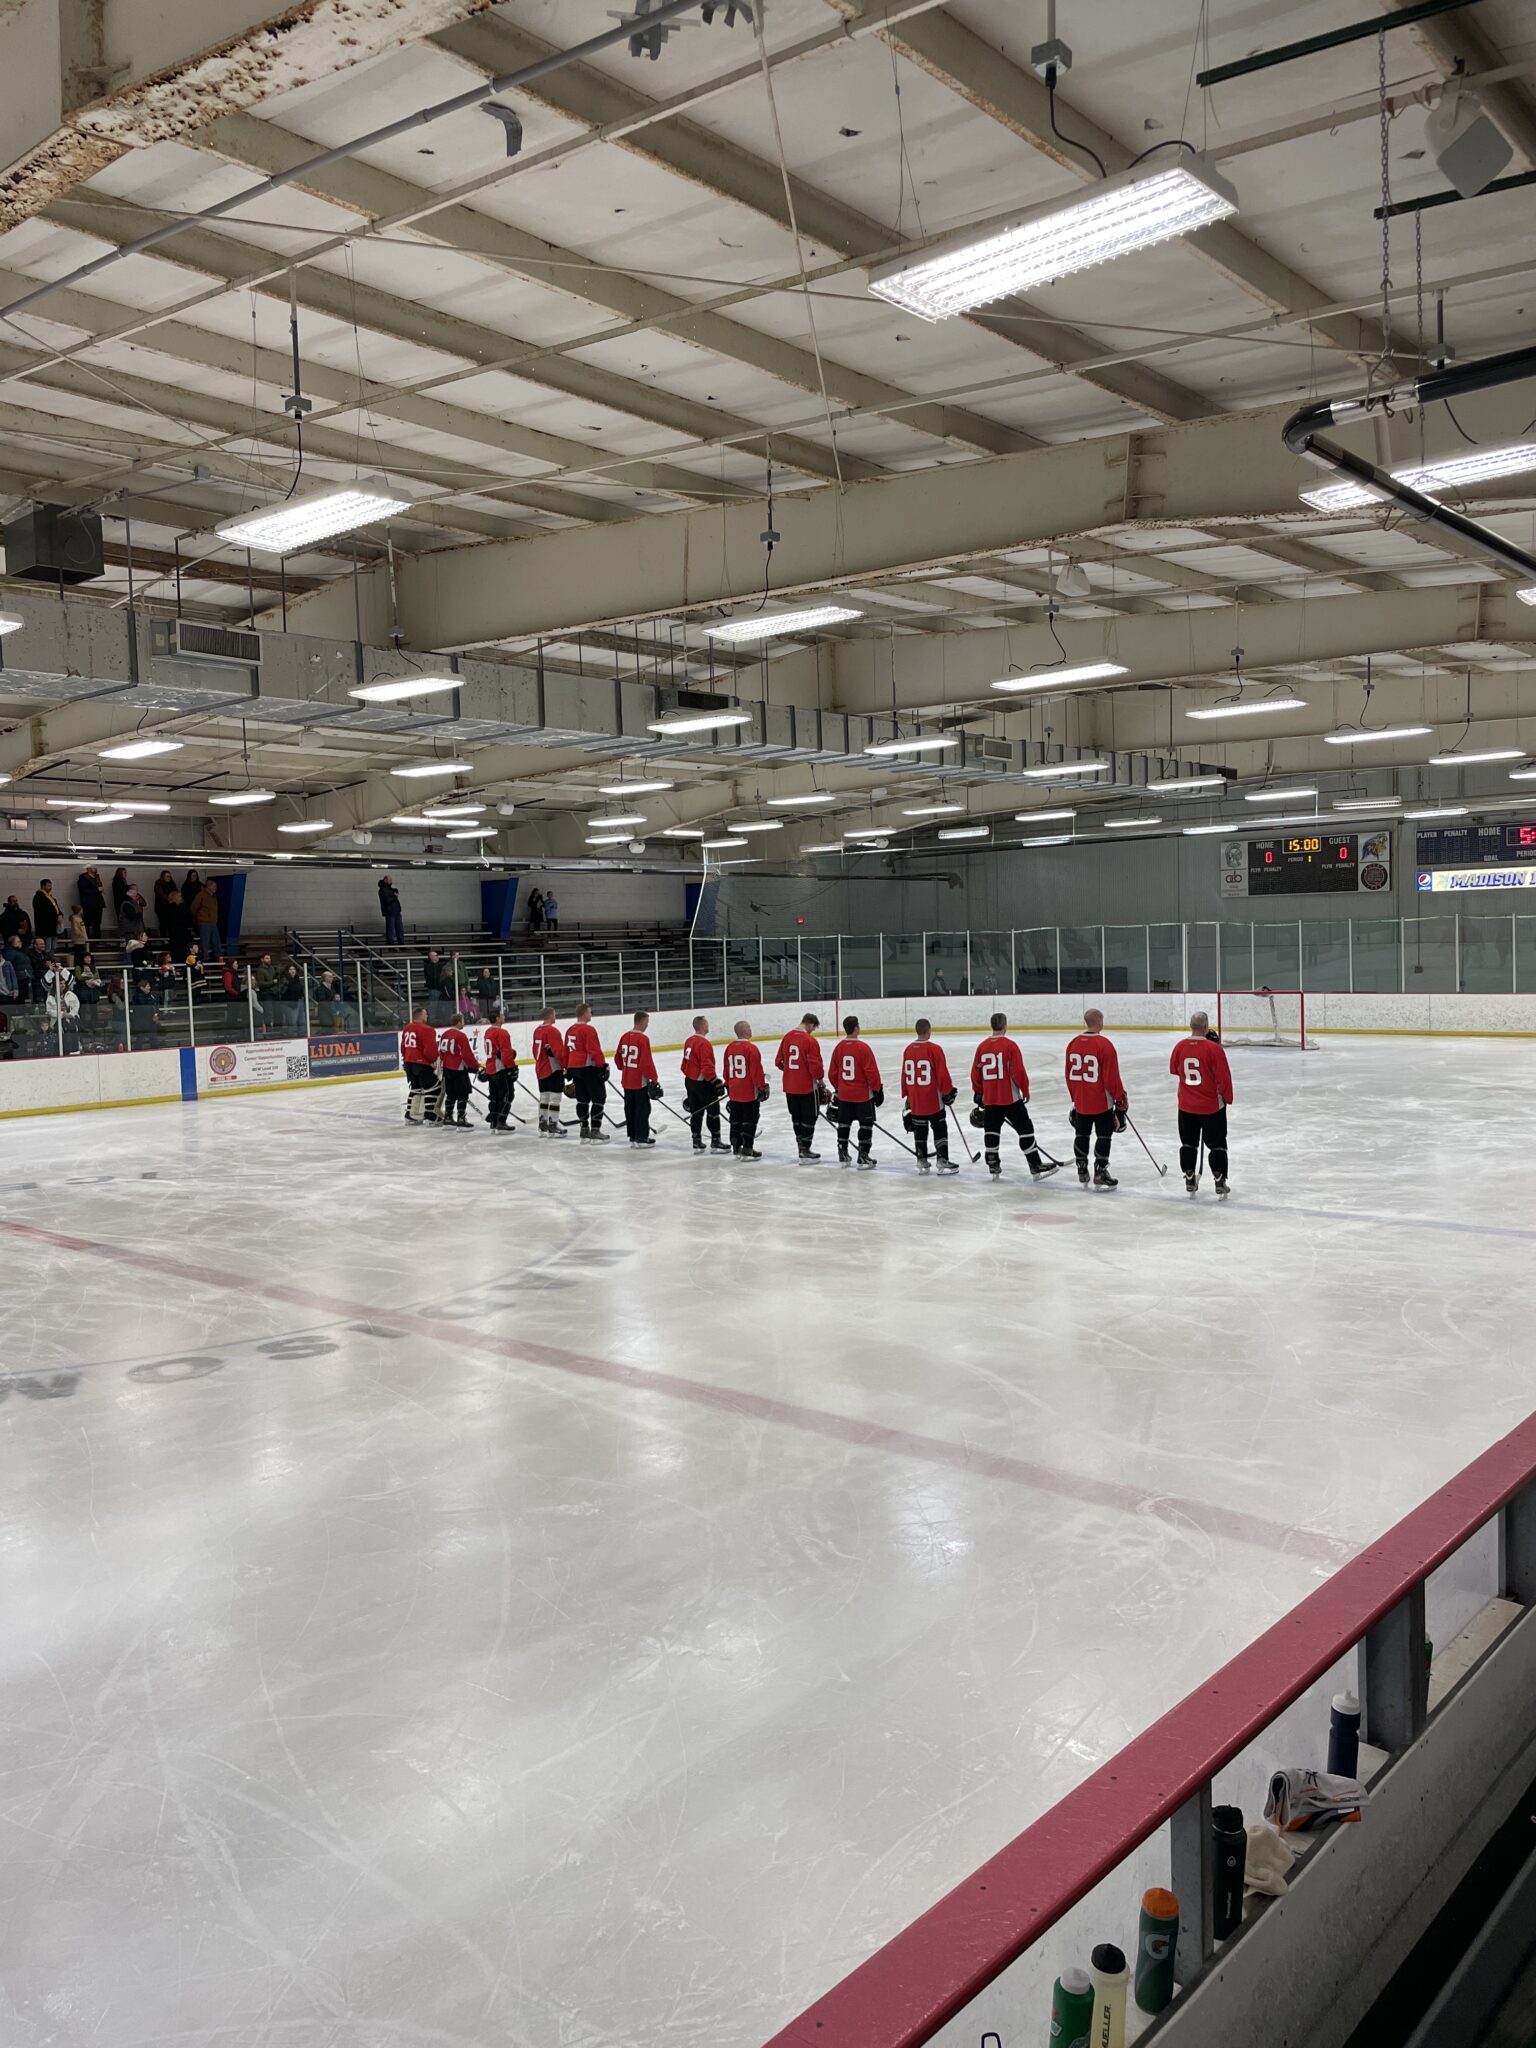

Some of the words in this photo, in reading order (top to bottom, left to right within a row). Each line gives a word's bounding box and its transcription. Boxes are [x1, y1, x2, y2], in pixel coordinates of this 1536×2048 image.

[1328, 836, 1351, 845] GUEST
[1443, 829, 1468, 838] PENALTY
[1478, 827, 1501, 836] HOME
[1256, 841, 1275, 849] HOME
[1288, 838, 1319, 851] 15:00
[1339, 847, 1348, 859] 0
[1265, 851, 1273, 863] 0
[1450, 871, 1527, 889] MADISON
[404, 1031, 417, 1048] 26
[309, 1041, 361, 1059] LiUNA!
[621, 1044, 639, 1068] 22
[788, 1044, 800, 1070] 2
[727, 1055, 747, 1079] 19
[841, 1055, 856, 1081] 9
[904, 1059, 932, 1086] 93
[980, 1053, 1005, 1080] 21
[1069, 1053, 1099, 1083] 23
[1183, 1057, 1202, 1086] 6
